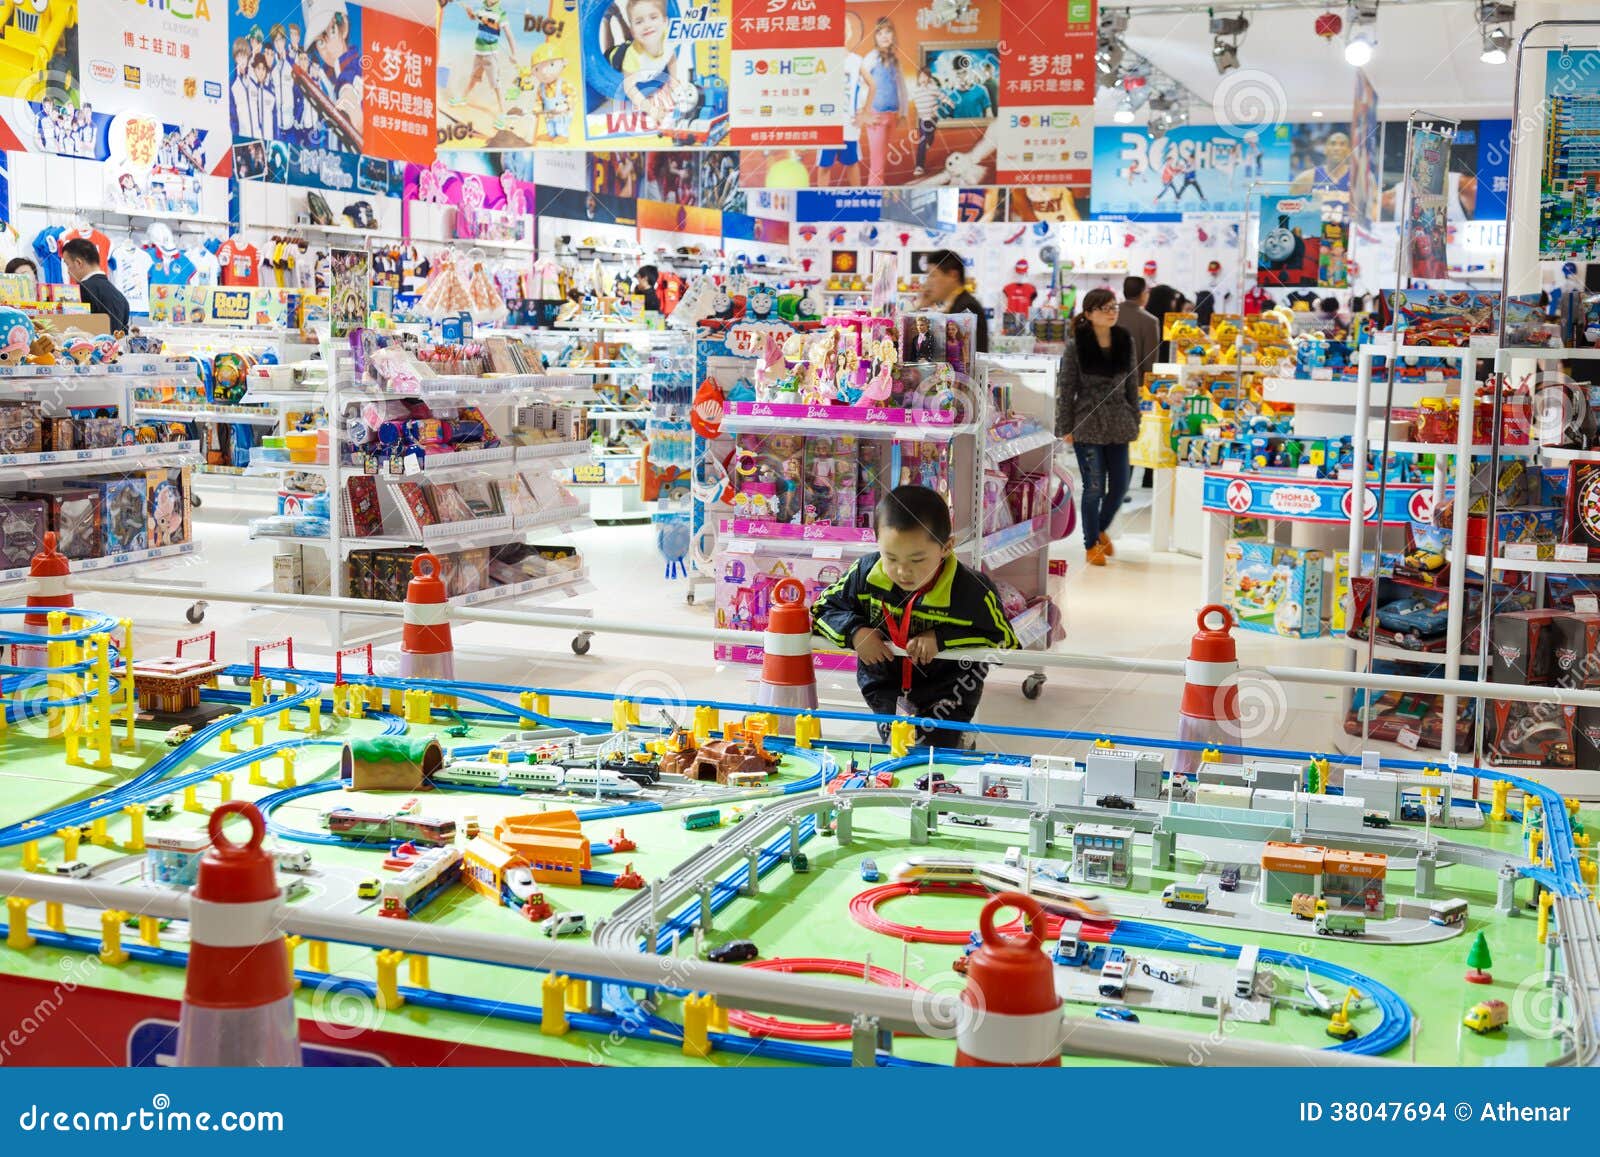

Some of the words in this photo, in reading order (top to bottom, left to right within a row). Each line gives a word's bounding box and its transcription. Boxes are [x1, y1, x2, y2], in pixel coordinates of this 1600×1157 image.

[524, 14, 564, 38] DIG!
[668, 20, 728, 39] ENGINE
[740, 15, 832, 33] 不再只是想象
[1006, 78, 1085, 93] 不再只是想象
[751, 404, 773, 417] Barbie
[807, 406, 829, 419] Barbie
[865, 409, 888, 422] Barbie
[1275, 492, 1316, 503] THOMAS
[747, 523, 769, 535] Barbie
[803, 526, 825, 538] Barbie
